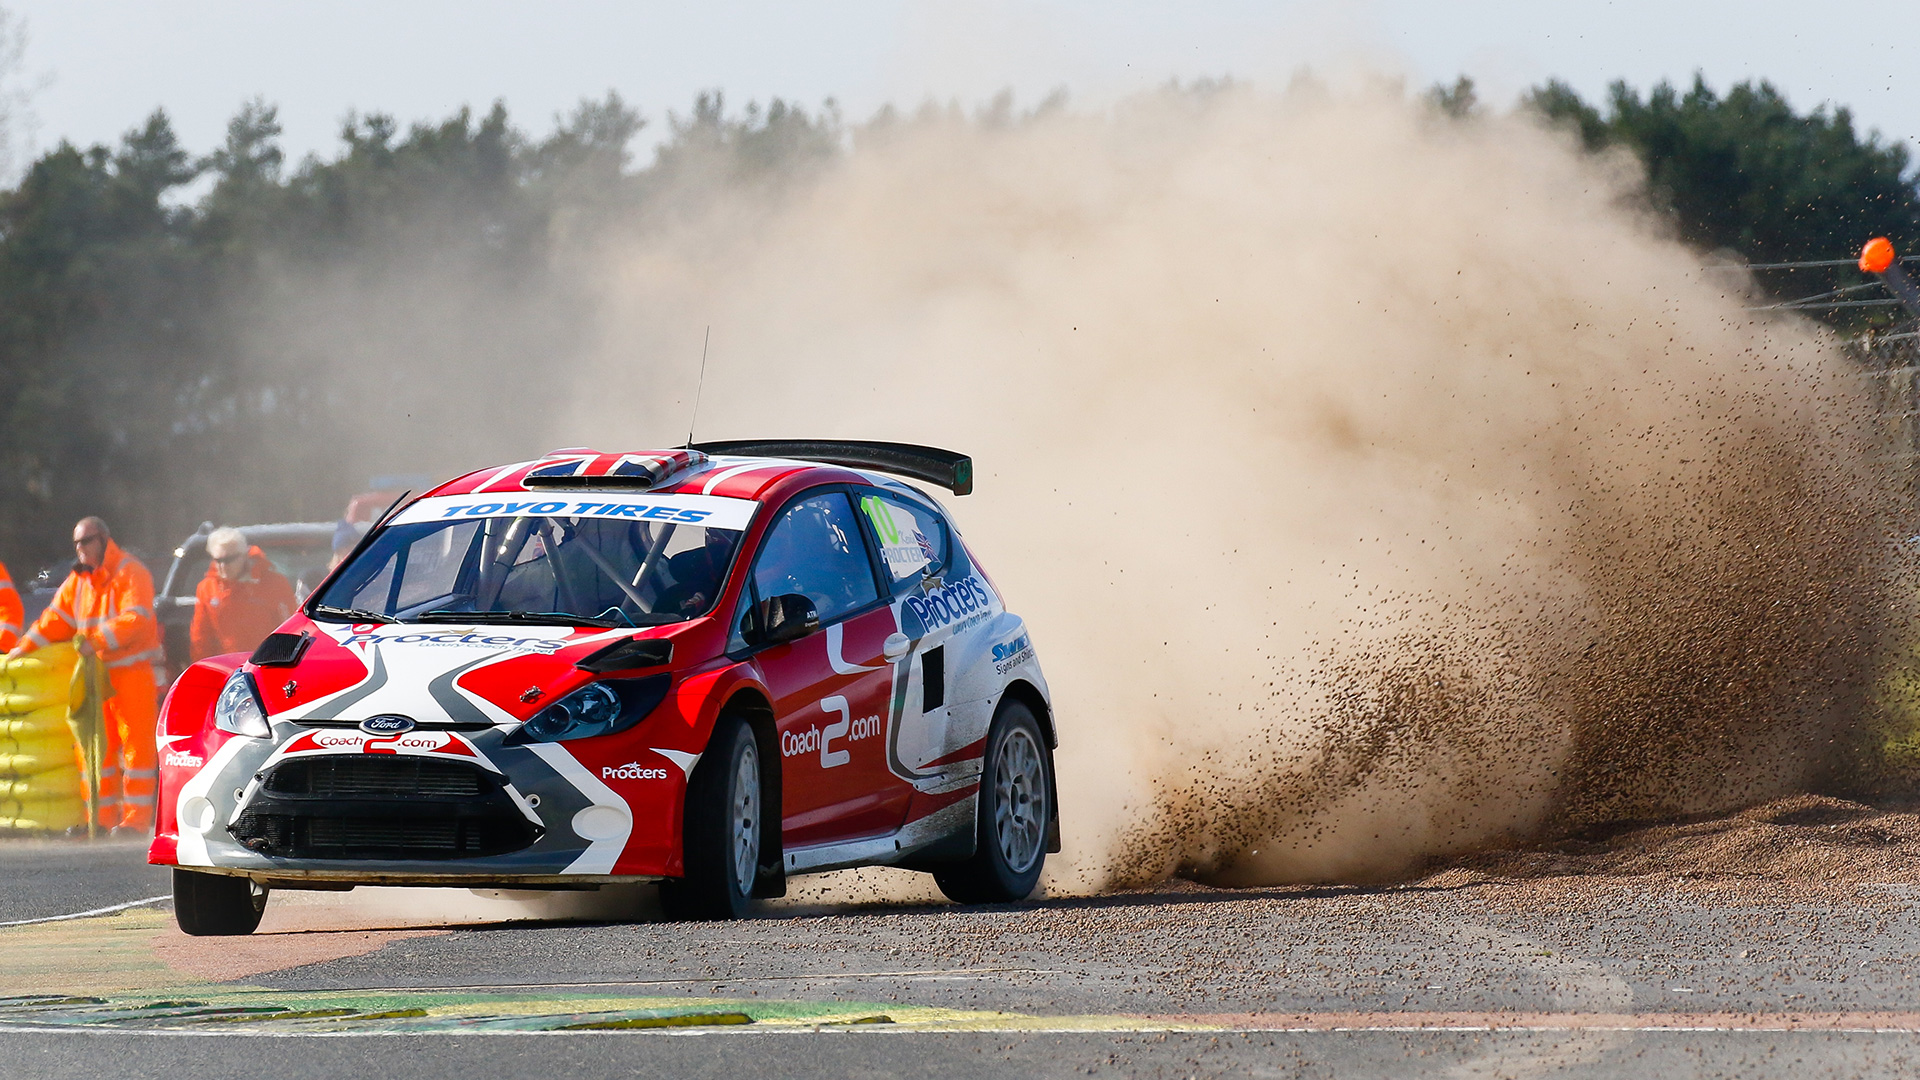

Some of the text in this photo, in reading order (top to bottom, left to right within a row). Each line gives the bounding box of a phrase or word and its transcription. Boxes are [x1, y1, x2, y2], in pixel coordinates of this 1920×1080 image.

[442, 502, 714, 523] TOYO TIRES
[861, 496, 899, 545] 10
[880, 546, 924, 563] PROCTER
[905, 576, 989, 633] Procters
[341, 632, 567, 650] Procters
[996, 661, 1013, 675] Signs
[1012, 654, 1022, 668] and
[370, 717, 402, 729] Ford
[165, 753, 203, 768] Procters
[602, 765, 667, 780] Procters
